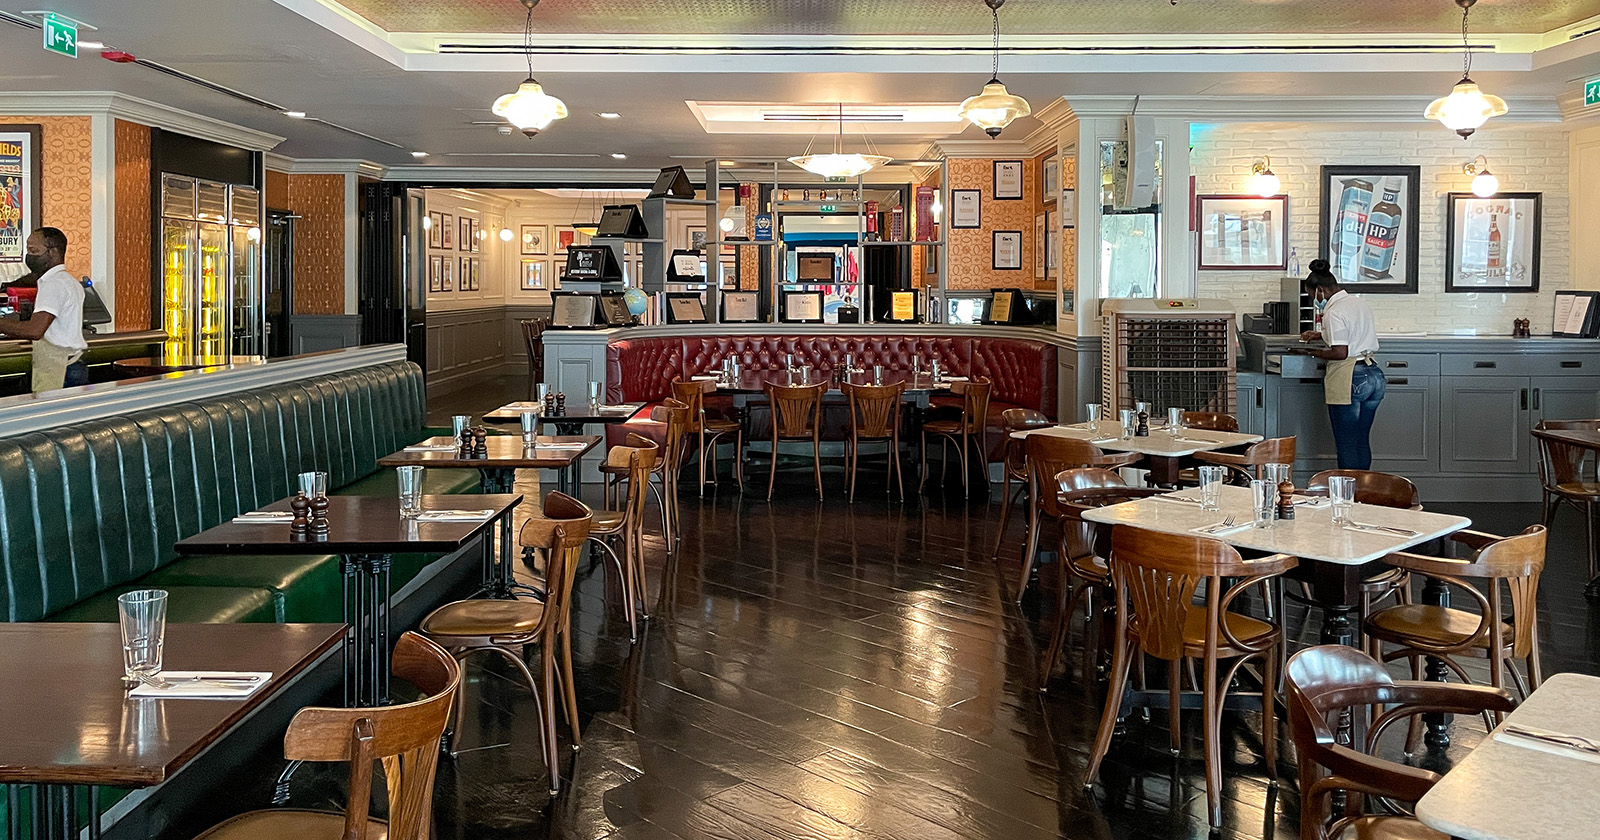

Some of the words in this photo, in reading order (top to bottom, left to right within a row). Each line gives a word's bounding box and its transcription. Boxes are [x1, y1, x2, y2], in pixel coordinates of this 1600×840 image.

[1469, 205, 1523, 220] OGNAC
[1369, 224, 1388, 238] HP
[1367, 237, 1384, 247] SAUCE
